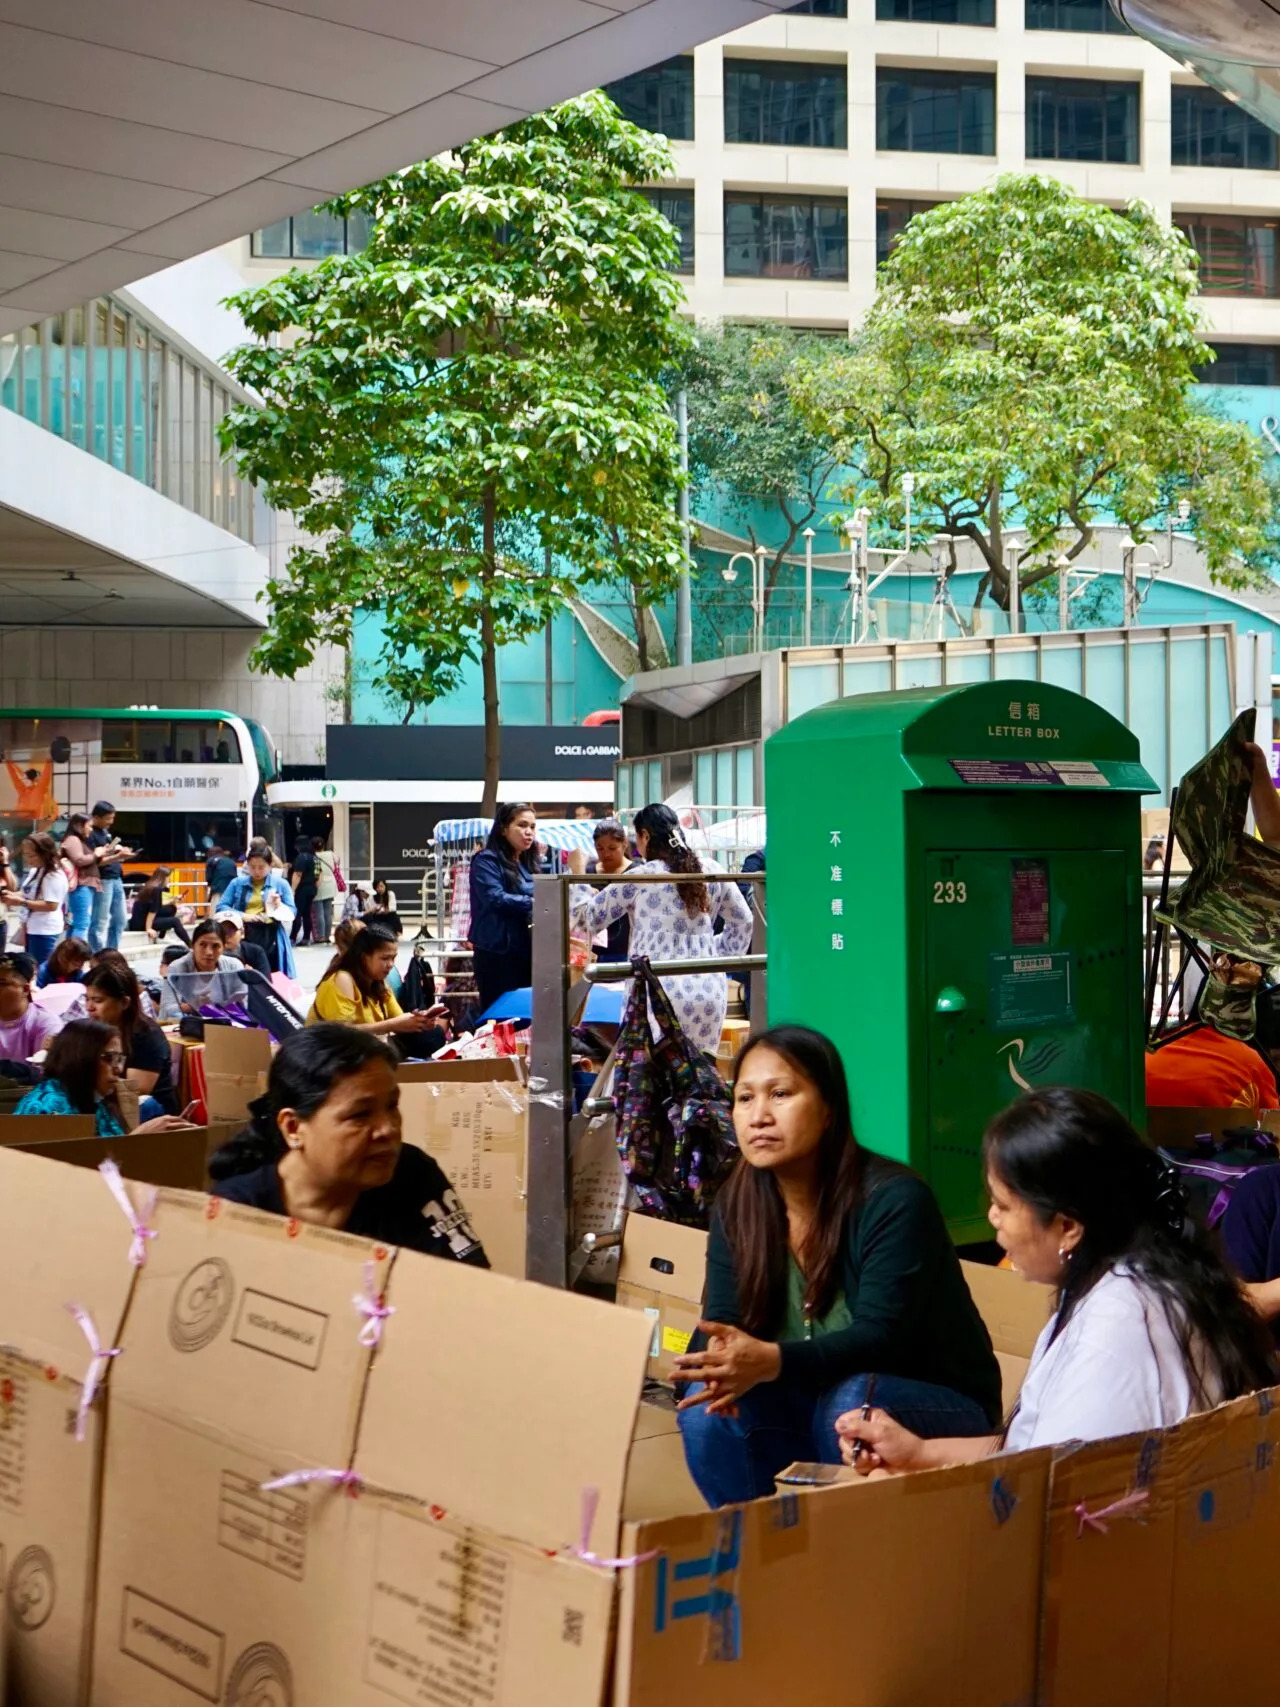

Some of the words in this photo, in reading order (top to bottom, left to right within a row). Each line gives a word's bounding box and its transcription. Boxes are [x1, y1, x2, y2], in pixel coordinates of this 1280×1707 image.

[1008, 701, 1041, 721] 信箱
[988, 725, 1032, 738] LETTER
[1037, 727, 1061, 739] BOX
[933, 881, 967, 904] 233
